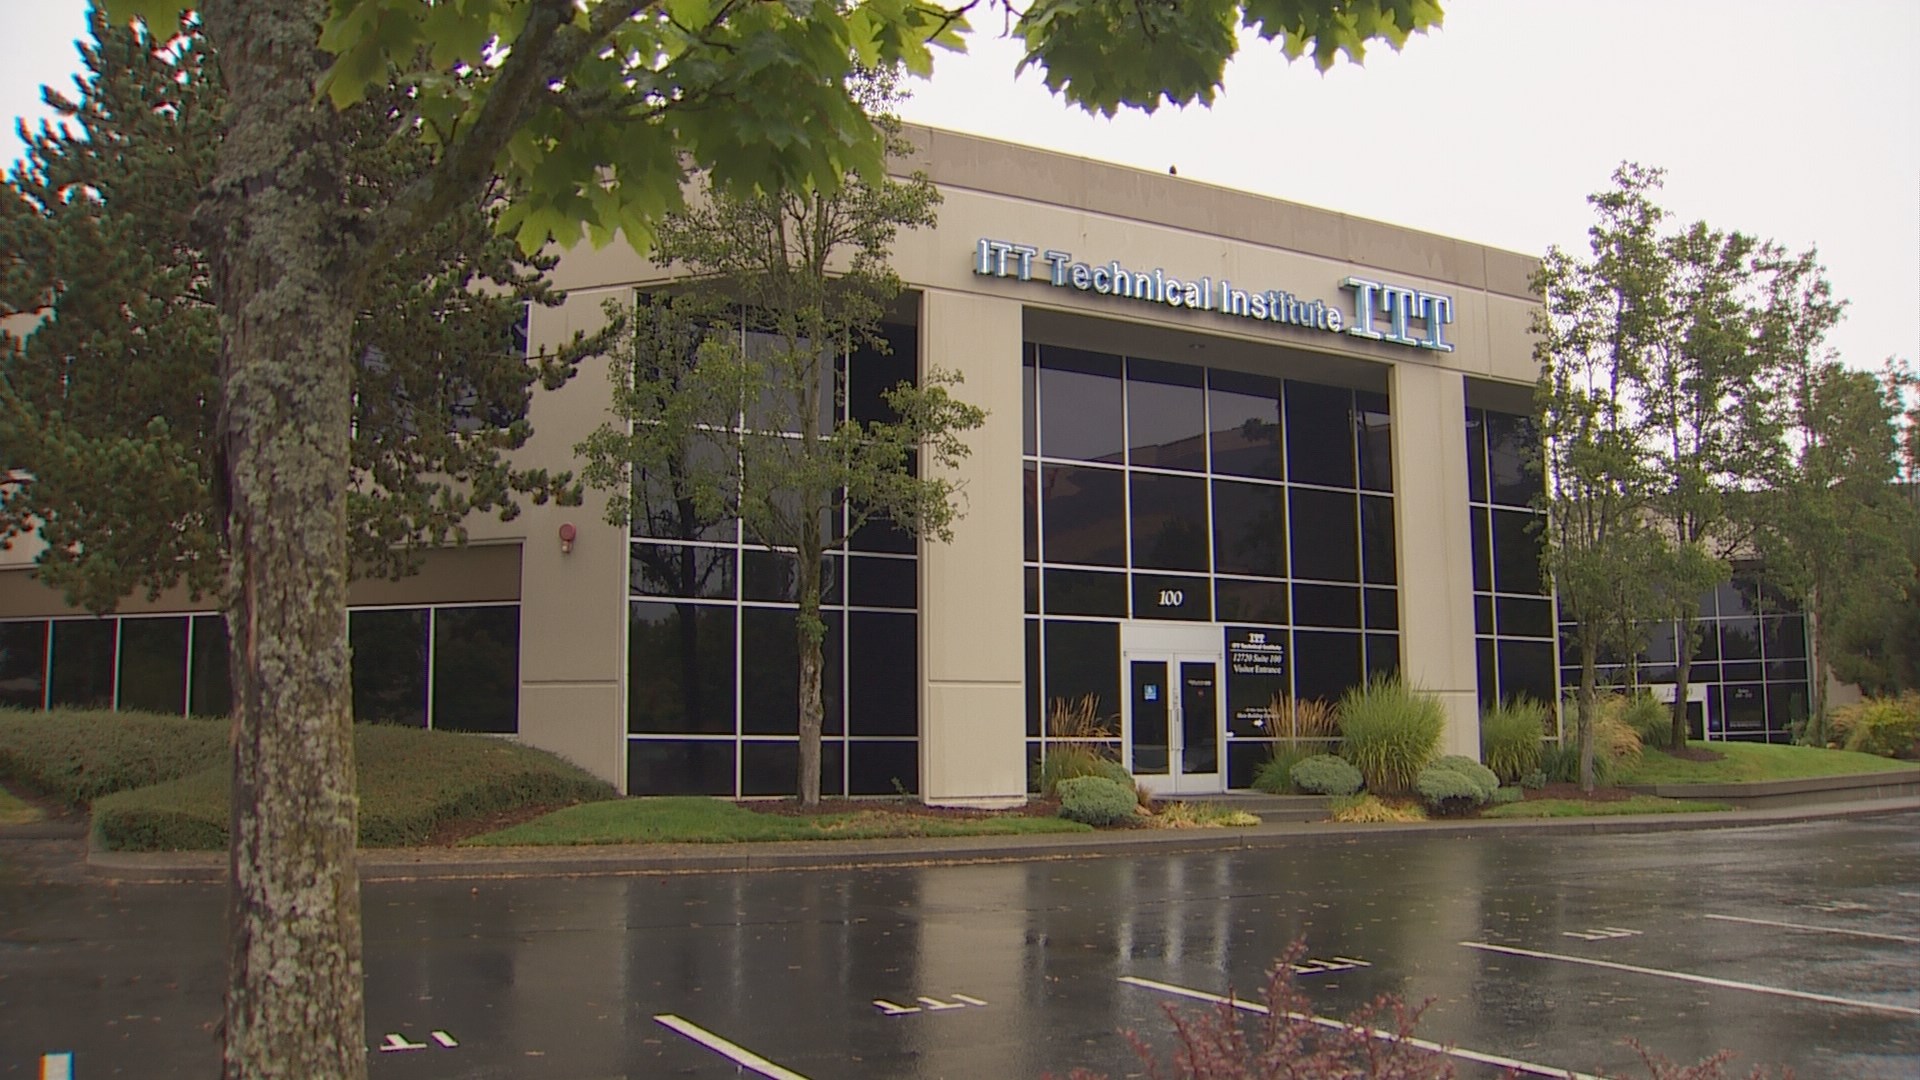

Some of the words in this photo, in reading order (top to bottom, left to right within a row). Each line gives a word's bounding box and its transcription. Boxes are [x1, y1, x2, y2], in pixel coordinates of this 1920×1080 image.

[975, 238, 1037, 281] ITT
[1044, 250, 1213, 311] Technical
[1218, 279, 1345, 333] Institute
[1338, 275, 1455, 352] ITT
[1159, 590, 1183, 606] 100
[1253, 653, 1269, 663] Suite
[1233, 663, 1254, 674] Visitor
[1254, 664, 1282, 675] Entrance
